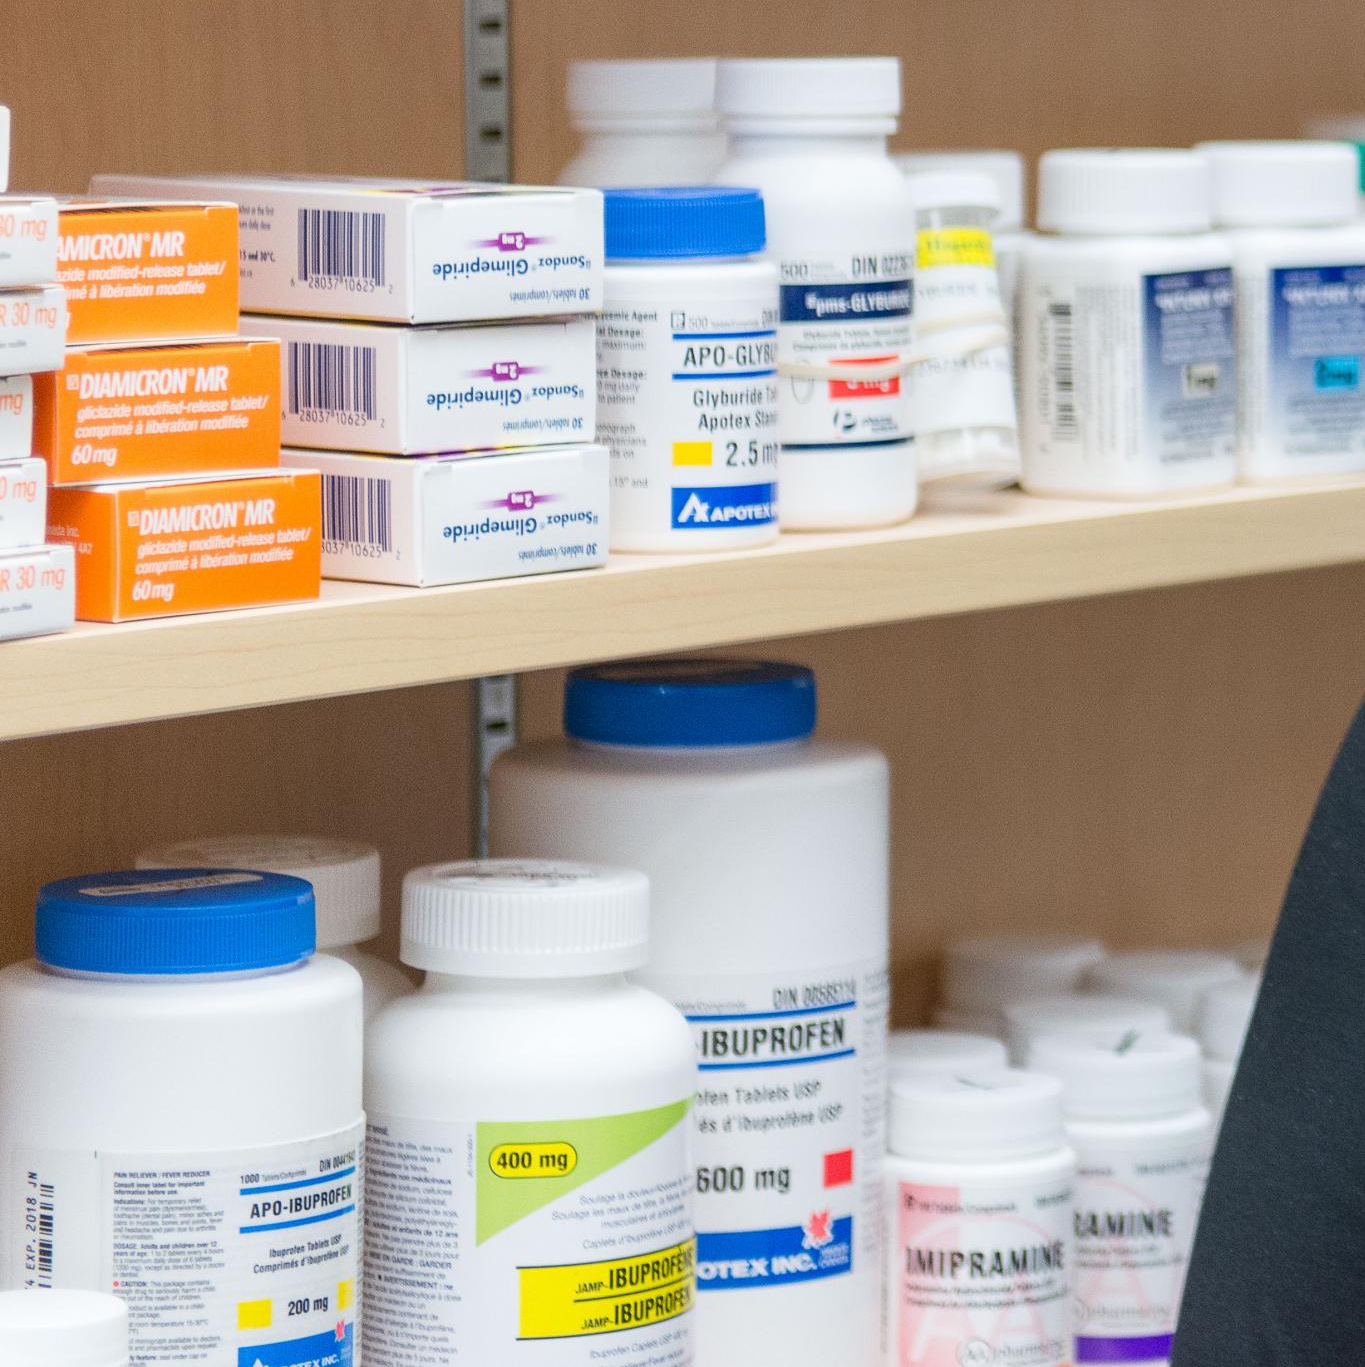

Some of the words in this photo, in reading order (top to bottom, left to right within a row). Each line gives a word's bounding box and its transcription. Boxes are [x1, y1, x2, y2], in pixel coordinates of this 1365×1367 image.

[21, 219, 48, 241] mg
[151, 231, 185, 258] MR
[88, 264, 184, 282] modified-release
[432, 257, 529, 281] Glimepiride
[780, 263, 808, 278] 500
[852, 256, 877, 276] DIN
[89, 285, 98, 299] à
[100, 283, 154, 300] libération
[156, 280, 206, 297] modifiée
[308, 276, 338, 290] 28037
[345, 277, 375, 293] 10625
[579, 287, 590, 300] 30
[12, 302, 30, 326] 30
[35, 307, 57, 328] mg
[195, 365, 229, 393] MR
[0, 393, 23, 415] mg
[77, 402, 130, 424] gliclazide
[134, 397, 228, 418] modified-release
[231, 394, 269, 412] tablet/
[427, 387, 522, 411] Glimepiride
[693, 386, 763, 410] Glyburide
[75, 419, 132, 440] comprimé
[135, 419, 144, 435] à
[145, 415, 198, 434] libération
[200, 413, 249, 431] modifiée
[300, 410, 330, 423] 28037
[336, 412, 367, 427] 10625
[572, 417, 583, 430] 30
[698, 413, 751, 432] Apotex
[726, 441, 758, 467] 2.5
[12, 479, 37, 502] mg
[244, 498, 275, 527] MR
[710, 502, 771, 523] APOTEX
[443, 517, 537, 543] Glimepiride
[137, 540, 188, 559] gliclazide
[189, 531, 275, 551] modified-release
[277, 527, 312, 544] tablet/
[351, 543, 382, 559] 10625
[586, 543, 597, 555] 30
[135, 557, 189, 576] comprimé
[190, 556, 198, 570] à
[199, 552, 248, 570] libération
[249, 546, 294, 565] modifiée
[16, 564, 36, 590] 30
[41, 567, 65, 590] mg
[735, 1087, 789, 1105] Tablets
[319, 1158, 331, 1172] DIN
[497, 1151, 532, 1170] 400
[540, 1152, 568, 1171] mg
[28, 1171, 38, 1188] JN
[240, 1173, 260, 1184] 1000
[697, 1166, 744, 1193] 600
[755, 1167, 790, 1193] mg
[250, 1183, 352, 1219] APO-IBUPROFEN
[26, 1197, 37, 1232] 2018
[25, 1238, 36, 1271] EXP.
[269, 1244, 305, 1258] Ibuprofen
[307, 1238, 330, 1251] Tablets
[906, 1240, 1065, 1278] IMIPRAMINE
[253, 1259, 299, 1274] Comprimés
[772, 1253, 818, 1275] INC.
[288, 1298, 309, 1316] 200
[313, 1297, 328, 1312] mg
